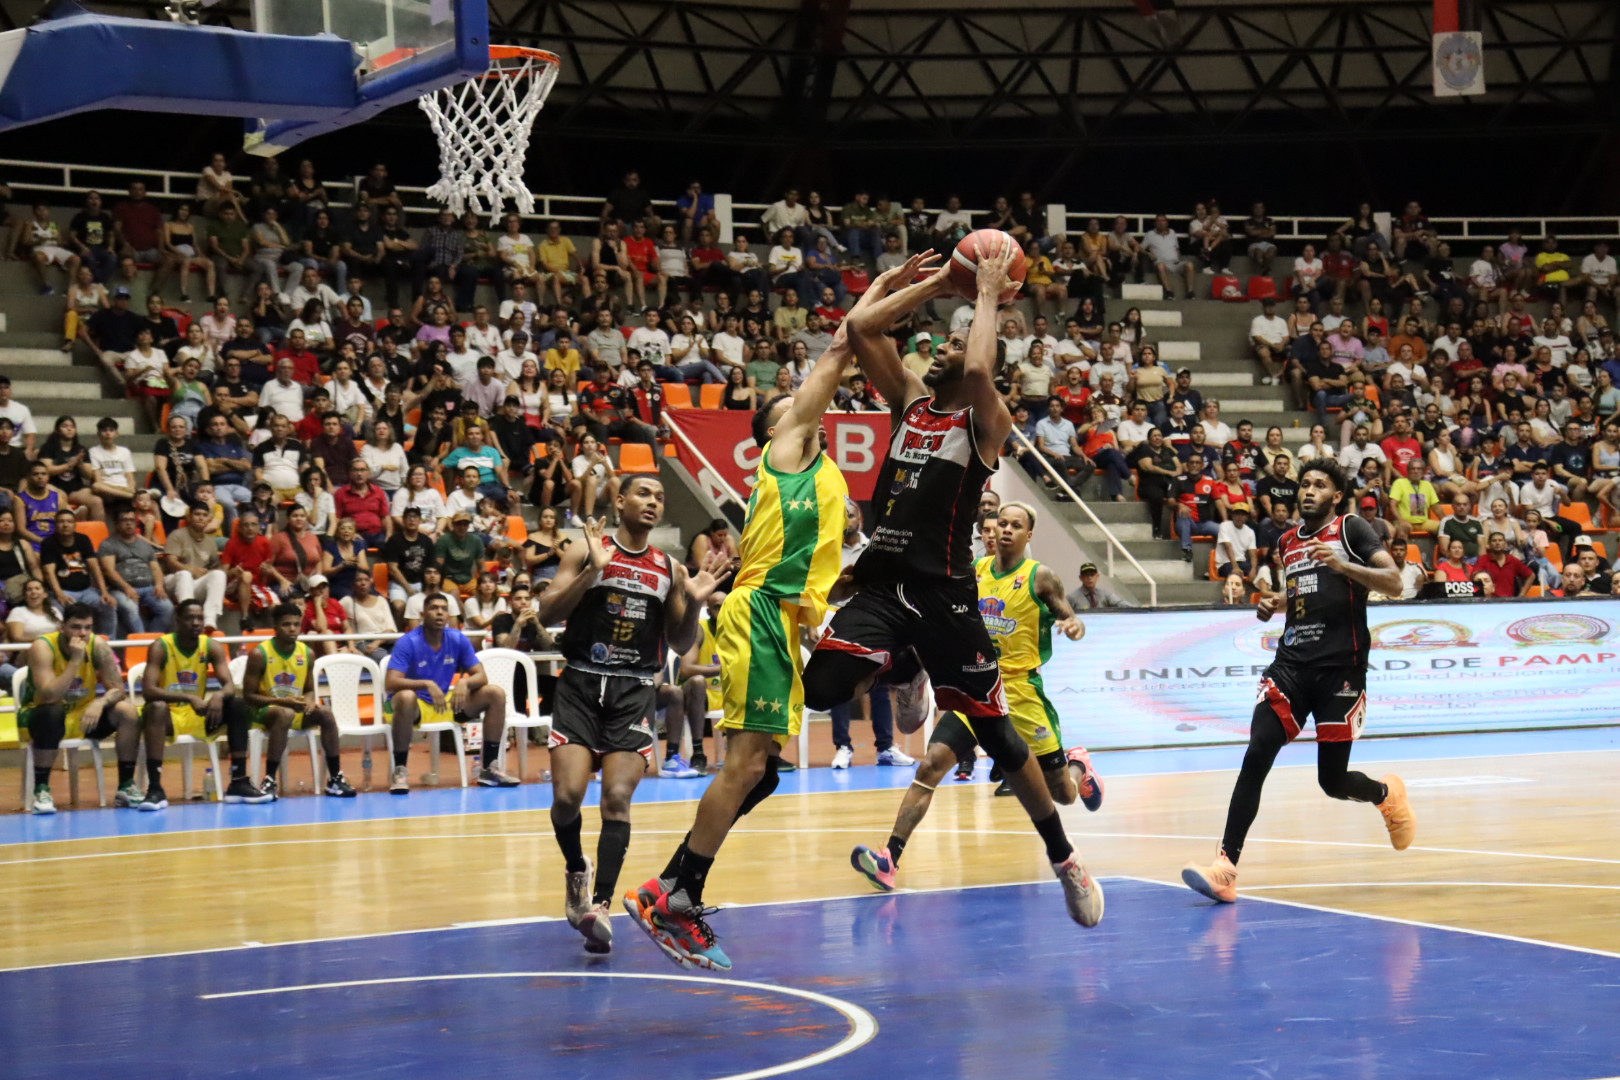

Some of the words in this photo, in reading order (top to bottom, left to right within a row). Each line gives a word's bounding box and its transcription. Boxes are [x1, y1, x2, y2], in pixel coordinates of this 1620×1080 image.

[1445, 581, 1474, 594] POSS
[1431, 656, 1481, 670] DE
[1498, 652, 1617, 668] PAMP
